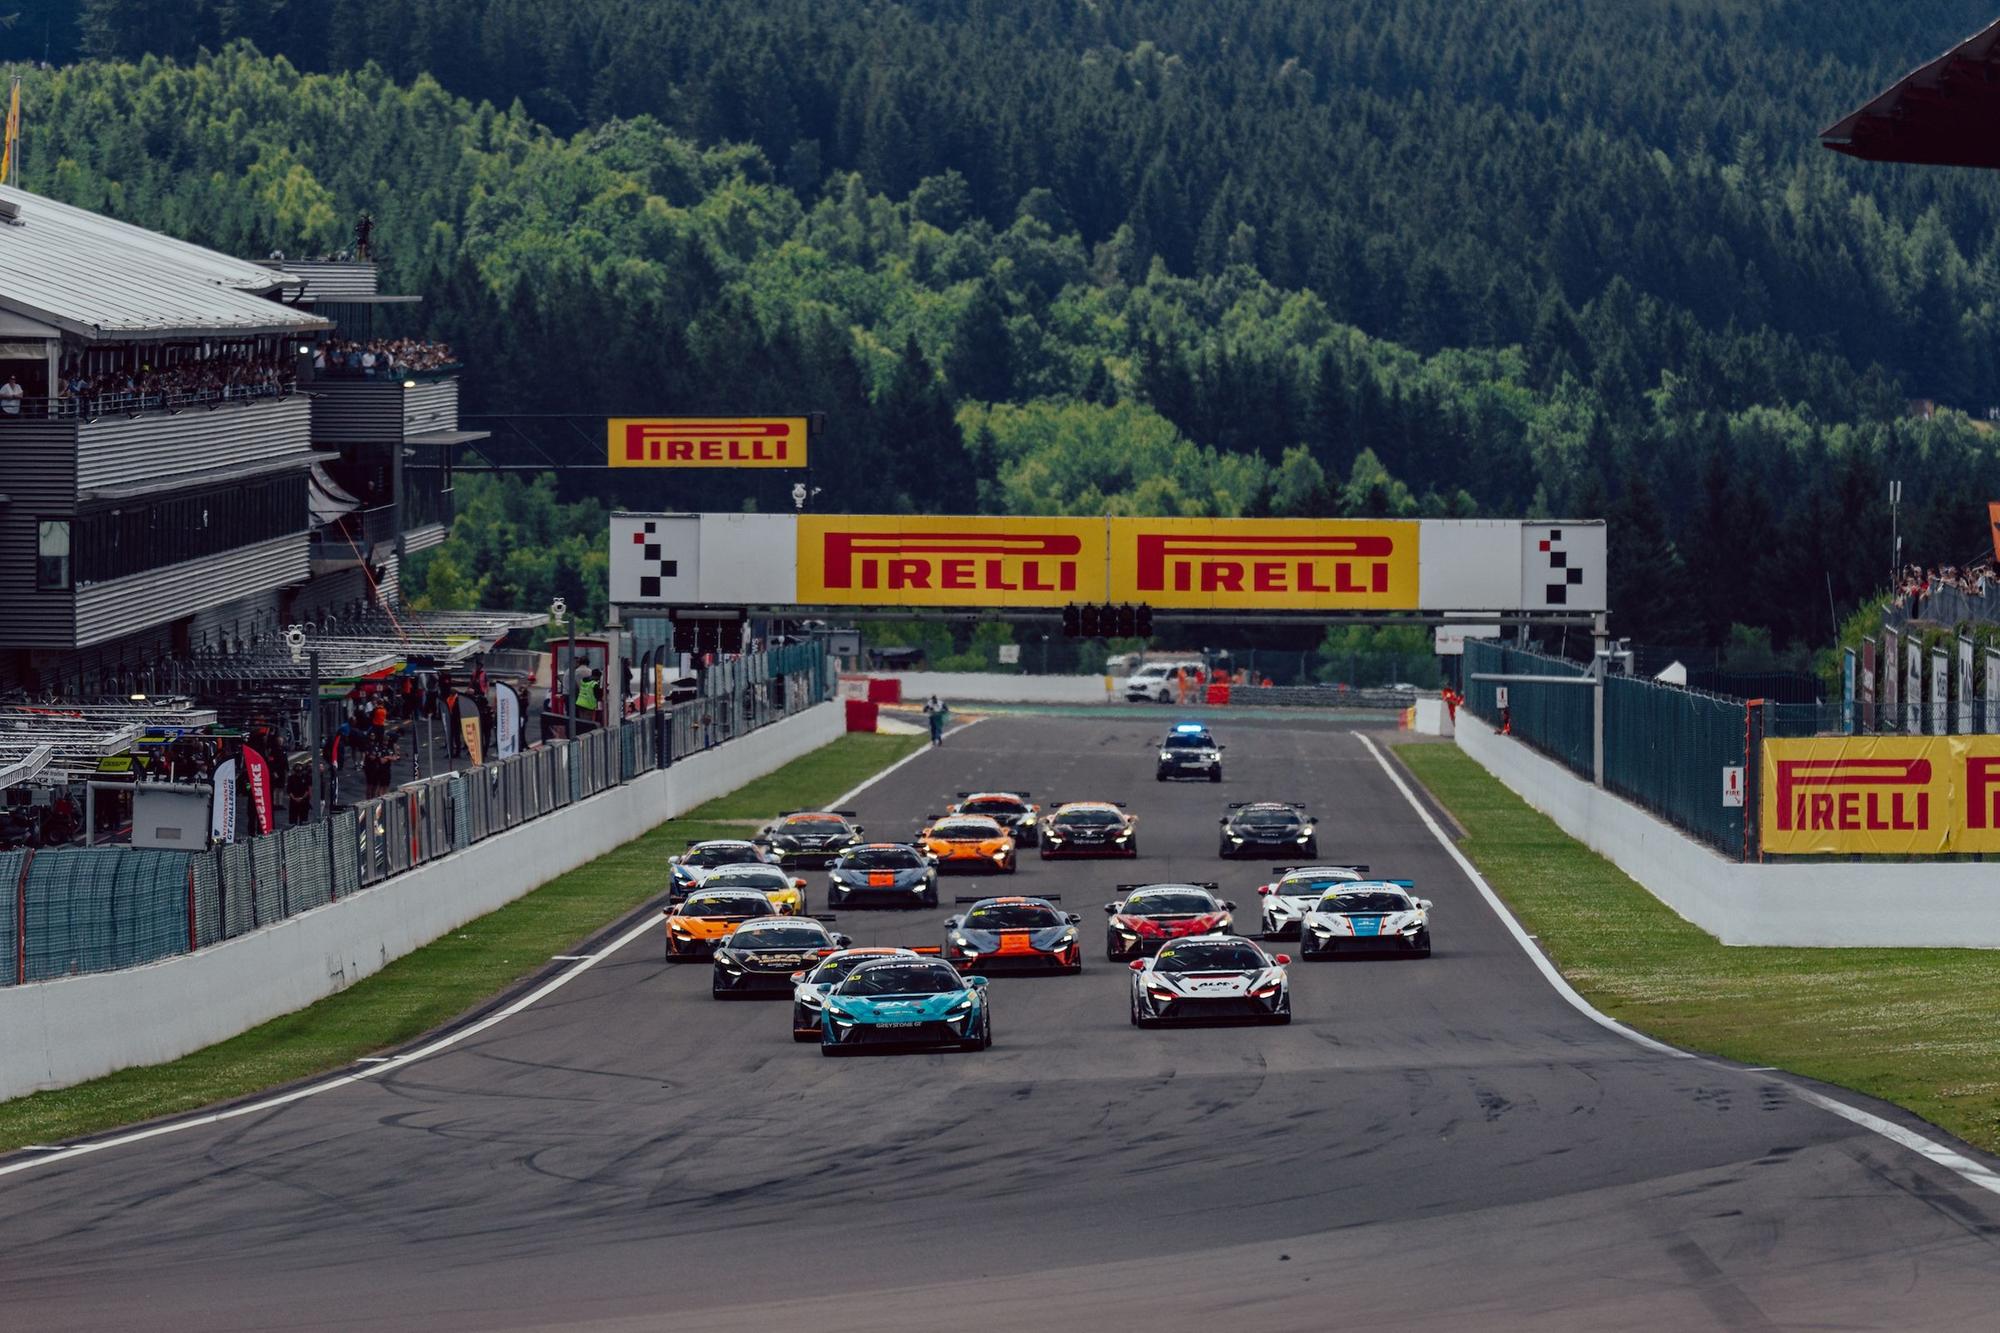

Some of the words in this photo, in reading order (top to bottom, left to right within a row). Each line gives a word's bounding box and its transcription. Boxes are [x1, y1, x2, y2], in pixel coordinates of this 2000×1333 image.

[626, 424, 790, 461] PIRELLI
[823, 532, 1082, 591] PIRELLI
[1137, 534, 1394, 593] PIRELLI
[1776, 758, 1932, 831] PIRELLI
